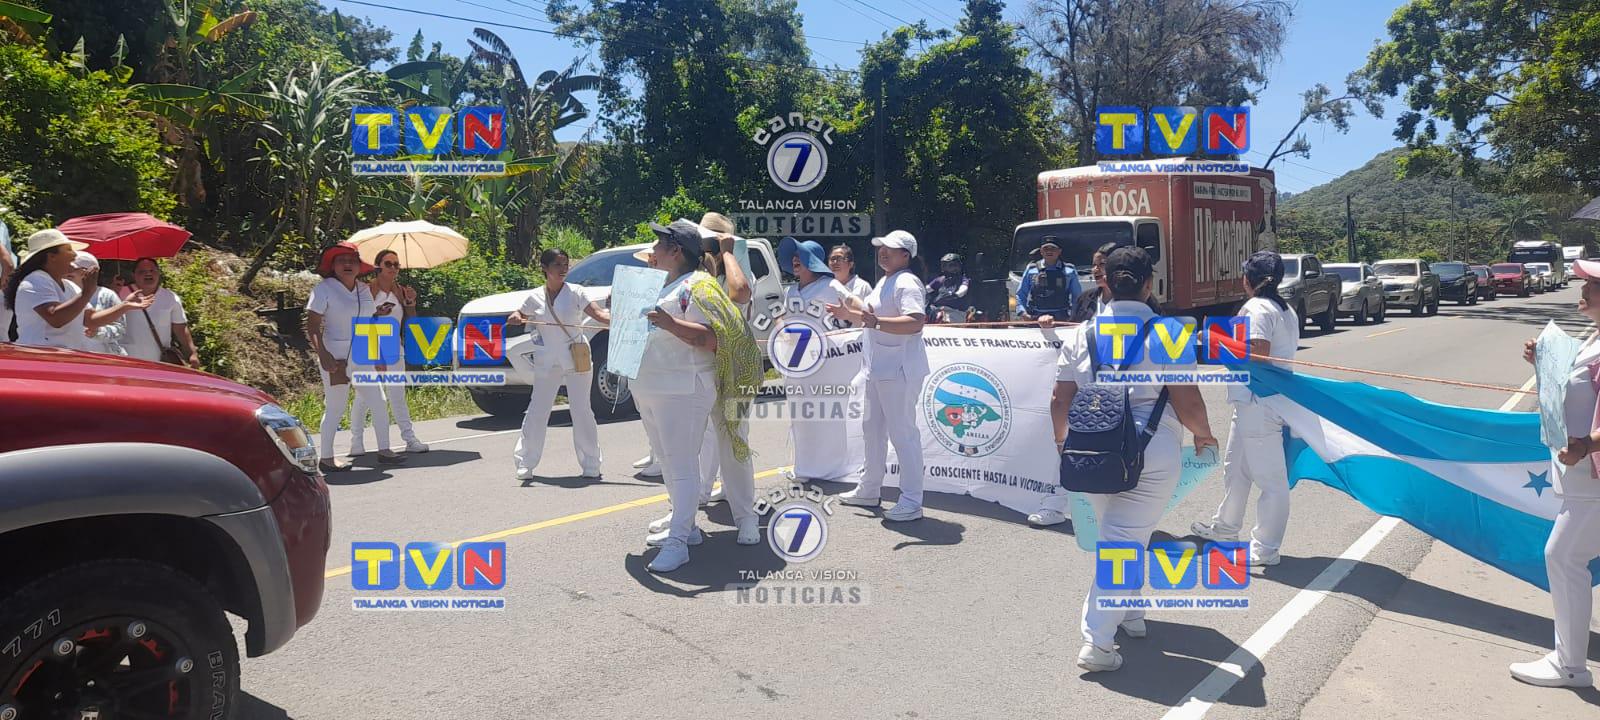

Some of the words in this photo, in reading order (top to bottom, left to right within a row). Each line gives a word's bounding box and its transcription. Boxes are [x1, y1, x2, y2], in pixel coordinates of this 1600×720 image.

[1075, 192, 1097, 217] LA
[1101, 188, 1151, 217] ROSA
[923, 337, 961, 348] NORTE
[965, 338, 978, 347] DE
[981, 338, 1042, 349] FRANCISCO
[930, 465, 981, 480] CONSCIENTE
[983, 469, 1008, 485] HASTA
[1009, 474, 1018, 486] LA
[3, 608, 61, 657] 771
